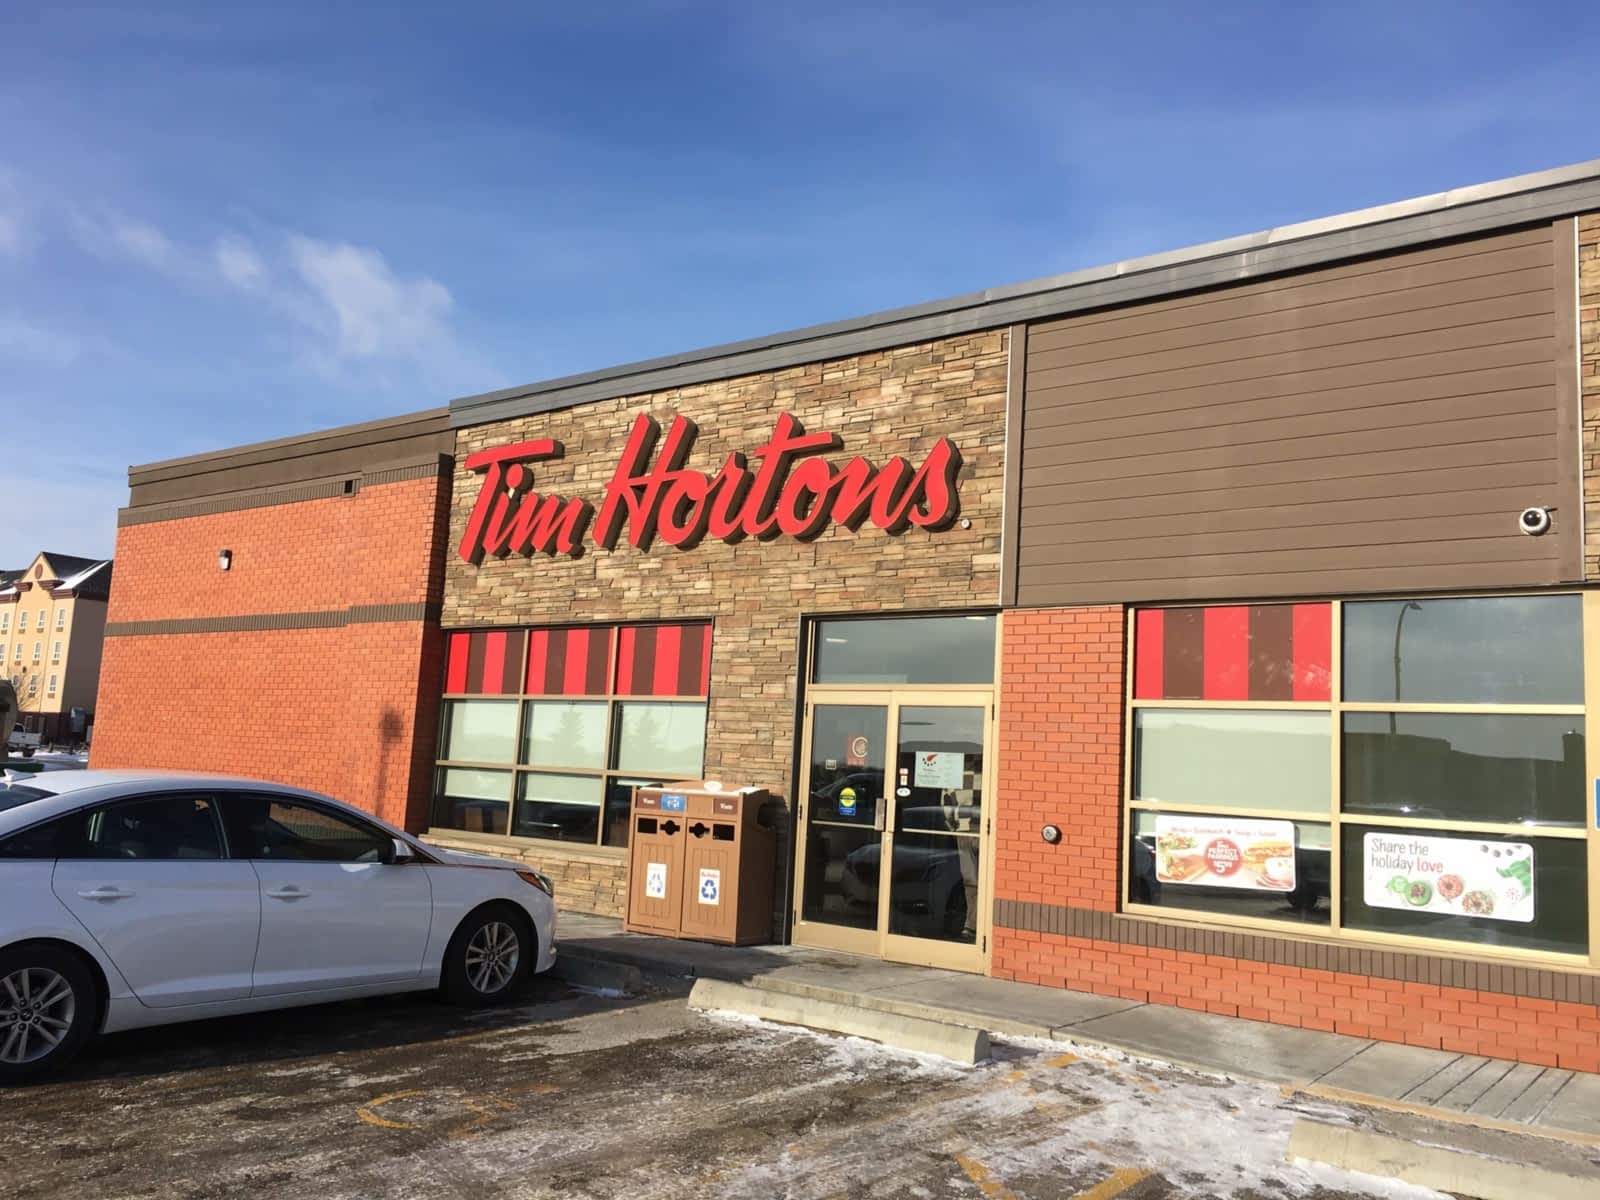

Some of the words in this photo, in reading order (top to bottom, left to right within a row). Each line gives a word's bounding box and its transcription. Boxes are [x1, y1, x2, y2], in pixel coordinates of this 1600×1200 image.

[458, 438, 592, 564] Tim
[592, 411, 958, 550] Hortons
[1371, 838, 1406, 854] Share
[1409, 841, 1429, 856] the
[1371, 853, 1414, 875] holiday
[1416, 856, 1444, 873] love
